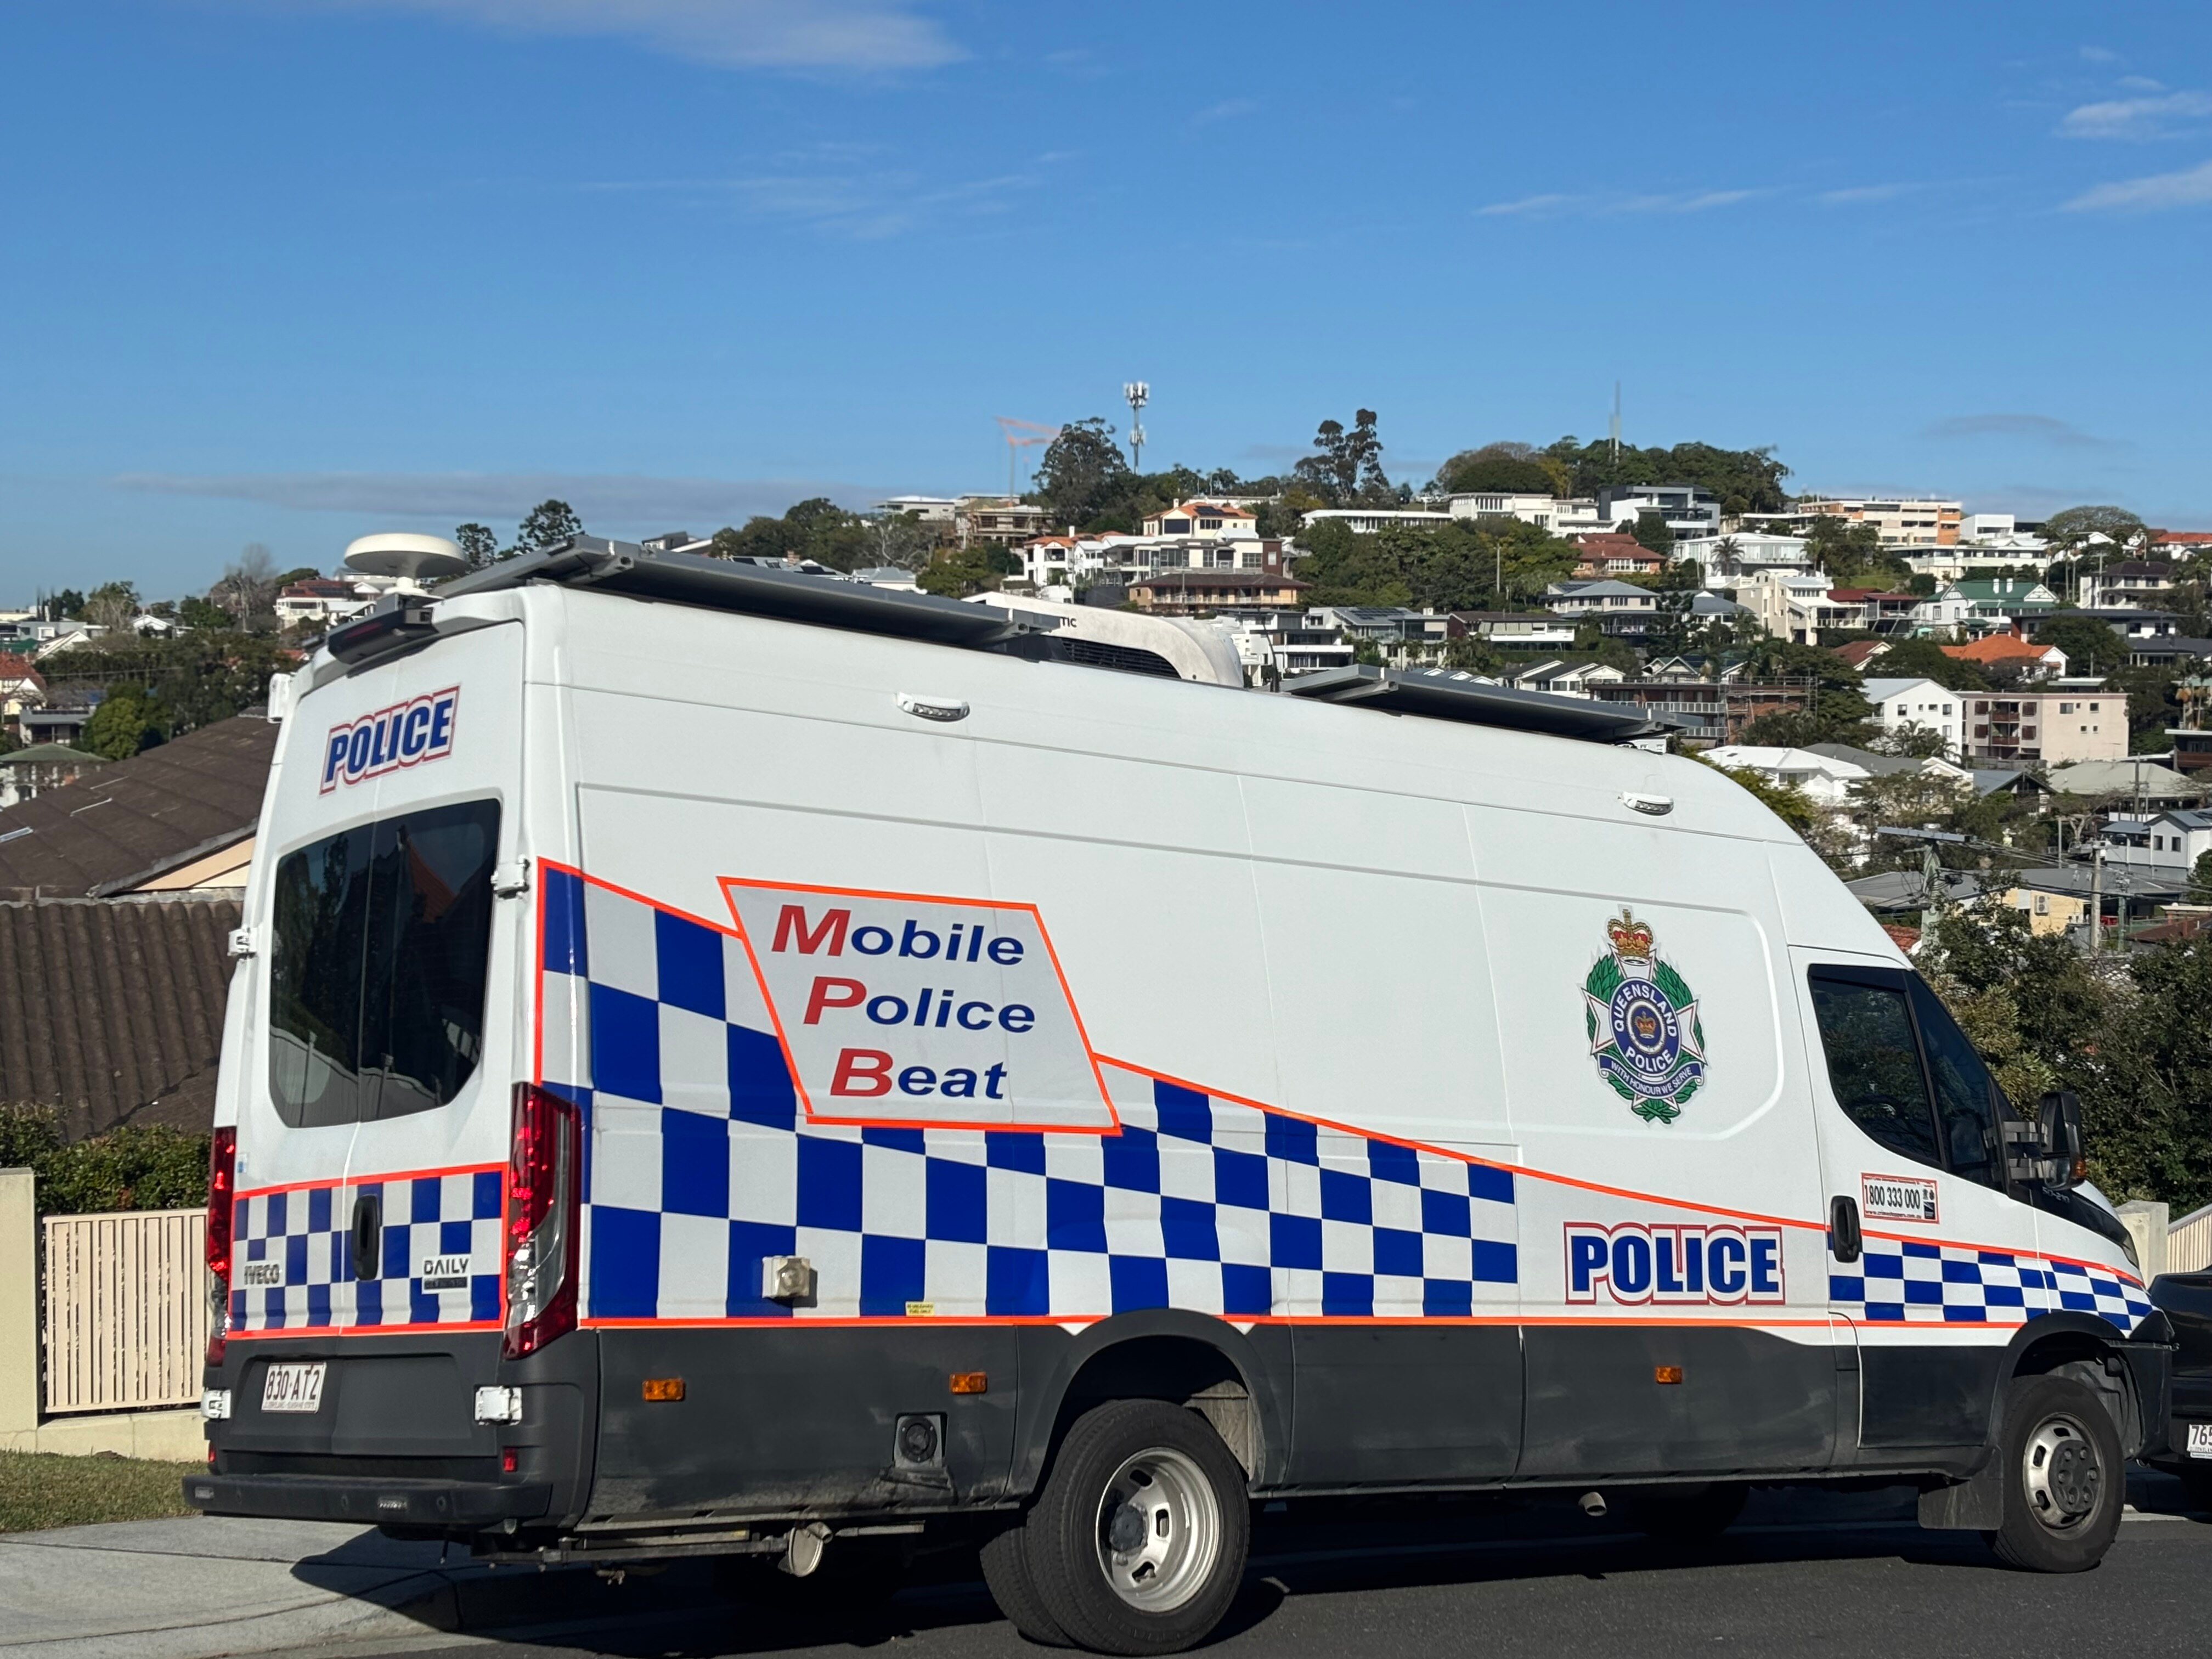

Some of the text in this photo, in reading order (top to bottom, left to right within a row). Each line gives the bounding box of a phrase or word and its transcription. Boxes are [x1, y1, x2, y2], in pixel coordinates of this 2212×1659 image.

[325, 697, 455, 784] POLICE
[771, 904, 1025, 966] Mobile
[803, 975, 1036, 1033] Police
[1613, 984, 1678, 1037] QUEENSLAND
[830, 1047, 1008, 1099] Beat
[1611, 1060, 1693, 1095] WITH HONOUR WE SERVE
[1625, 1046, 1674, 1072] POLICE
[1864, 1184, 1921, 1210] 1800 333 000
[244, 1263, 280, 1285] IVECO
[424, 1258, 469, 1275] DAILY
[1570, 1234, 1781, 1294] POLICE
